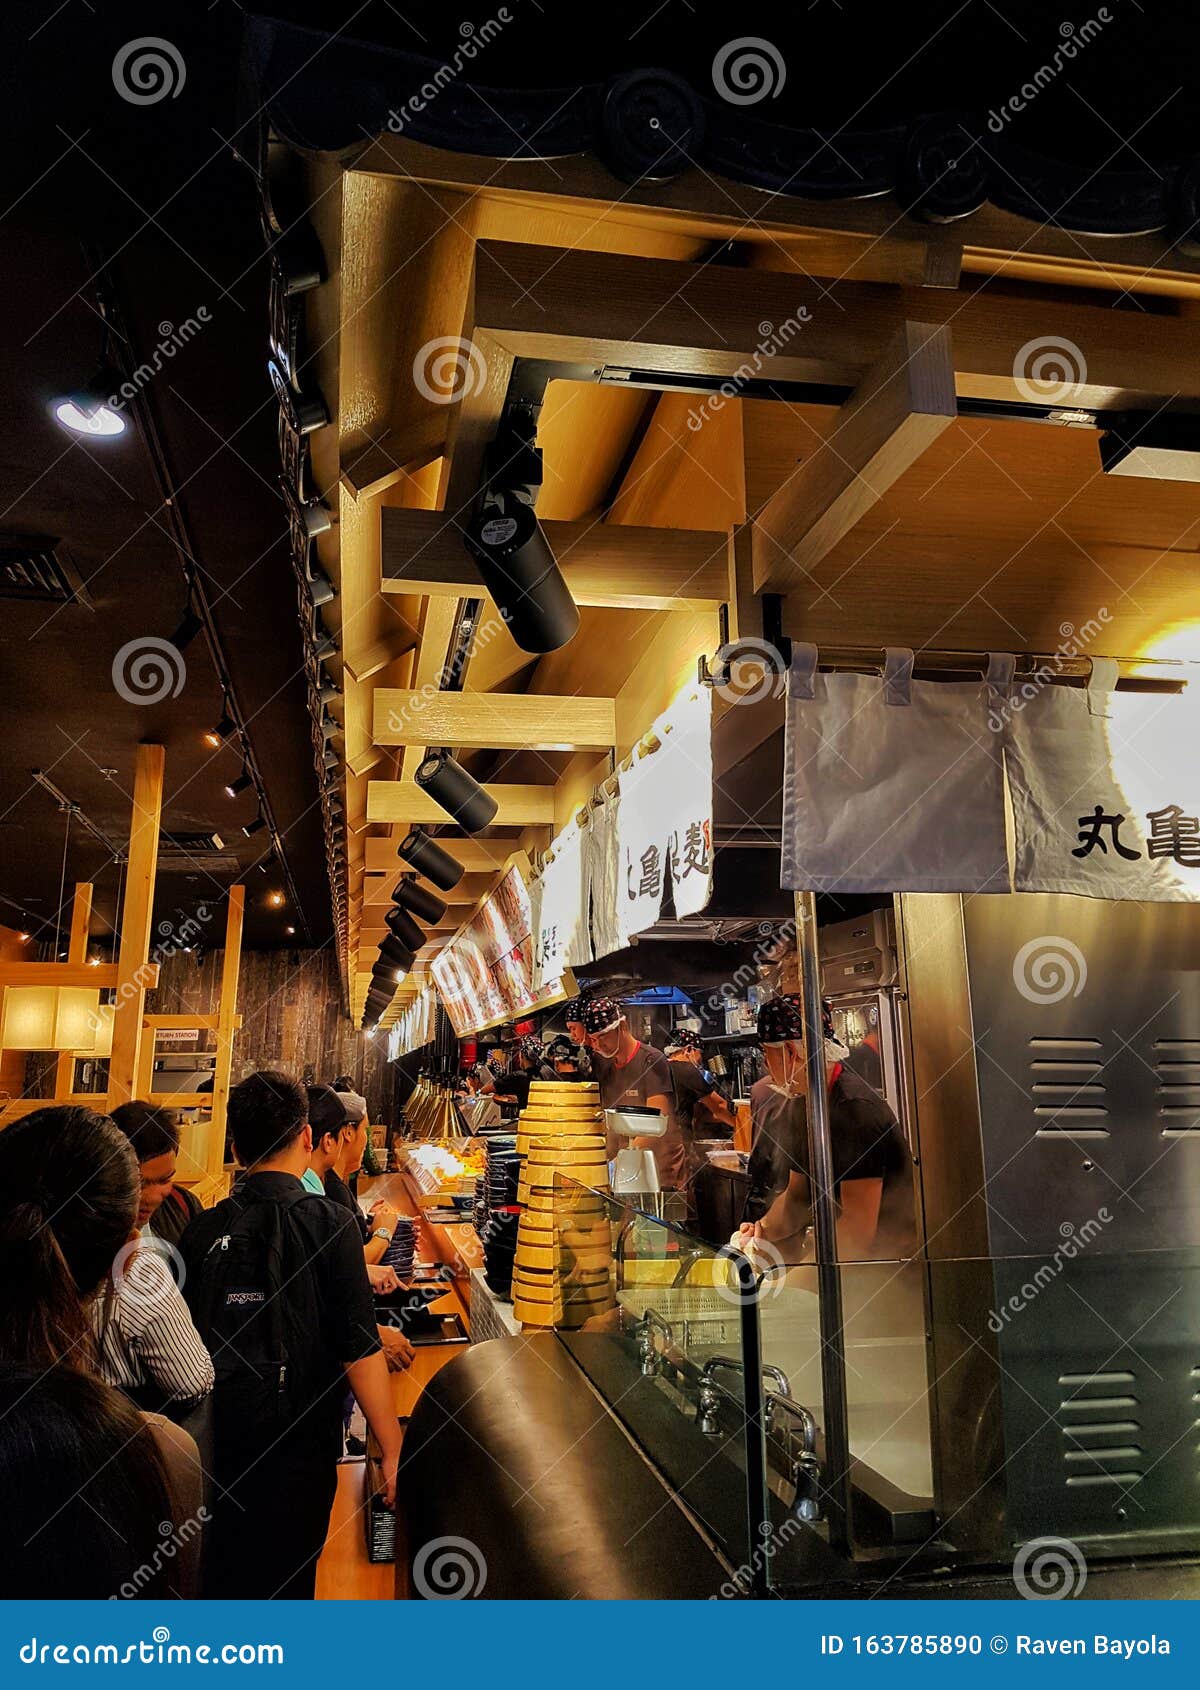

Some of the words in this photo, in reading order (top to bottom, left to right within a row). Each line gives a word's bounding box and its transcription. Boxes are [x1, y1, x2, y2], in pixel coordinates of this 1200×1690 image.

[1071, 805, 1200, 868] 丸亀
[155, 1031, 174, 1039] ETURN
[175, 1031, 197, 1039] STATION
